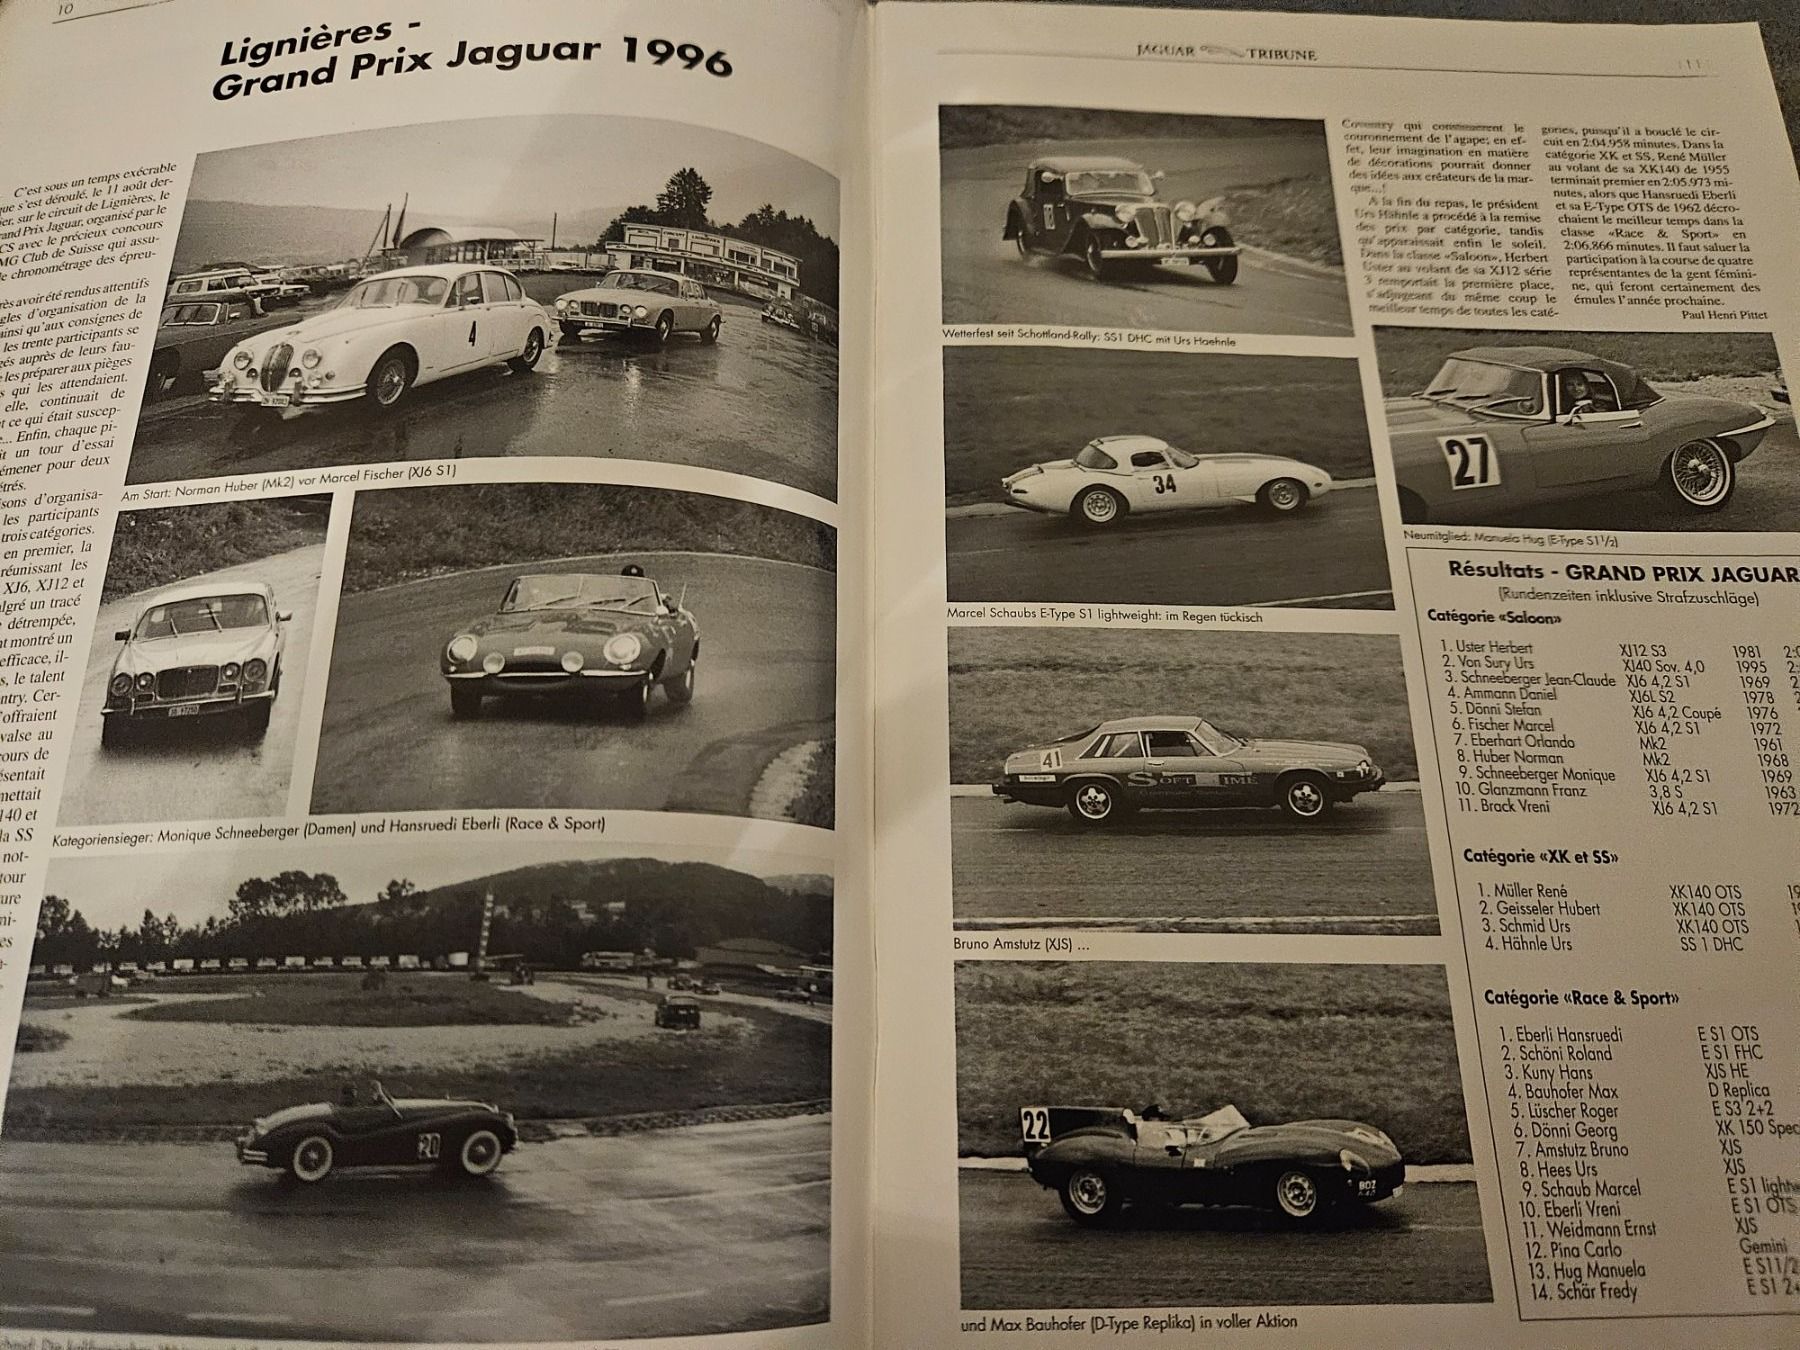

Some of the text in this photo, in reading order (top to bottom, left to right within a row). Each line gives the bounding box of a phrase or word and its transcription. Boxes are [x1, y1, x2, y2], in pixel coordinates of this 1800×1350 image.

[58, 3, 74, 15] 10
[220, 22, 392, 66] Lignières
[1137, 44, 1317, 61] JAGUAR TRIBUNE
[212, 36, 733, 101] Grand Prix Jaguar 1996
[45, 183, 68, 191] sous
[71, 179, 84, 187] un
[87, 173, 120, 184] temps
[123, 162, 176, 178] exécrable
[1555, 202, 1566, 210] et
[1583, 201, 1624, 213] E-Type
[1627, 202, 1654, 212] OTS
[1656, 202, 1670, 212] de
[1674, 203, 1701, 213] 1962
[1703, 203, 1740, 213] décro-
[1568, 267, 1756, 281] représentantes de la gent fémini-
[1681, 310, 1768, 319] Paul Henri Pittet
[467, 320, 477, 347] 4
[942, 327, 994, 338] Wetterfest
[997, 329, 1014, 337] seit
[1104, 332, 1122, 342] SS1
[1127, 333, 1152, 343] DHC
[1173, 336, 1191, 345] Urs
[1193, 336, 1236, 346] Haehnle
[1447, 436, 1489, 487] 27
[120, 464, 457, 502] Am Start: Norman Huber (Mk2) vor Marcel Fischer (XJ6 S1)
[1152, 473, 1177, 494] 34
[3, 507, 99, 526] les participants
[1, 525, 94, 543] trois catégories.
[1547, 534, 1584, 547] (E-Type
[1448, 560, 1544, 579] Résultats
[1565, 564, 1646, 581] GRAND
[1652, 566, 1705, 582] PRIX
[1710, 566, 1800, 583] JAGUAR
[3, 577, 84, 594] XJ6, XJ12 et
[1498, 586, 1759, 607] (Rundenzeiten inklusive Strafzuschläge)
[946, 606, 1263, 624] Marcel Schaubs E-Type S1 lightweight: im Regen tückisch
[1427, 608, 1495, 625] Catégorie
[1440, 639, 1761, 658] 1. Uster Herbert XJ12 S3 1981
[1444, 670, 1770, 689] 3. Schneeberger Jean-Claude XJ6 4,2 S1 1969
[1454, 732, 1782, 751] 7. Eberhart Orlando Mk2 1961
[1041, 750, 1062, 769] 41
[1455, 781, 1796, 800] 10. Glanzmann Franz 3,8 S 1963
[52, 832, 153, 849] Kategoriensieger:
[157, 830, 211, 844] Monique
[215, 823, 298, 840] Schneeberger
[303, 820, 356, 839] (Damen)
[360, 819, 386, 833] und
[389, 816, 457, 832] Hansruedi
[462, 815, 500, 830] Eberli
[505, 816, 543, 832] (Race
[564, 816, 605, 833] Sport)
[1463, 847, 1618, 867] Catégorie «XK et SS»
[1478, 882, 1742, 900] 1. Müller René XK140 OTS
[953, 937, 989, 949] Bruno
[993, 937, 1040, 950] Amstutz
[1045, 937, 1072, 953] (XJS)
[1484, 988, 1559, 1009] Catégorie
[1563, 989, 1608, 1005] «Race
[1630, 989, 1679, 1009] Sport»
[1499, 1025, 1759, 1042] 1. Eberli Hansruedi E S1 OTS
[1508, 1081, 1770, 1101] 4. Bauhofer Max D Replica
[1023, 1109, 1049, 1140] 22
[1522, 1217, 1758, 1238] 11. Weidmann Ernst XJS
[960, 1312, 1298, 1334] und Max Bauhofer (D-Type Replika) in voller Aktion
